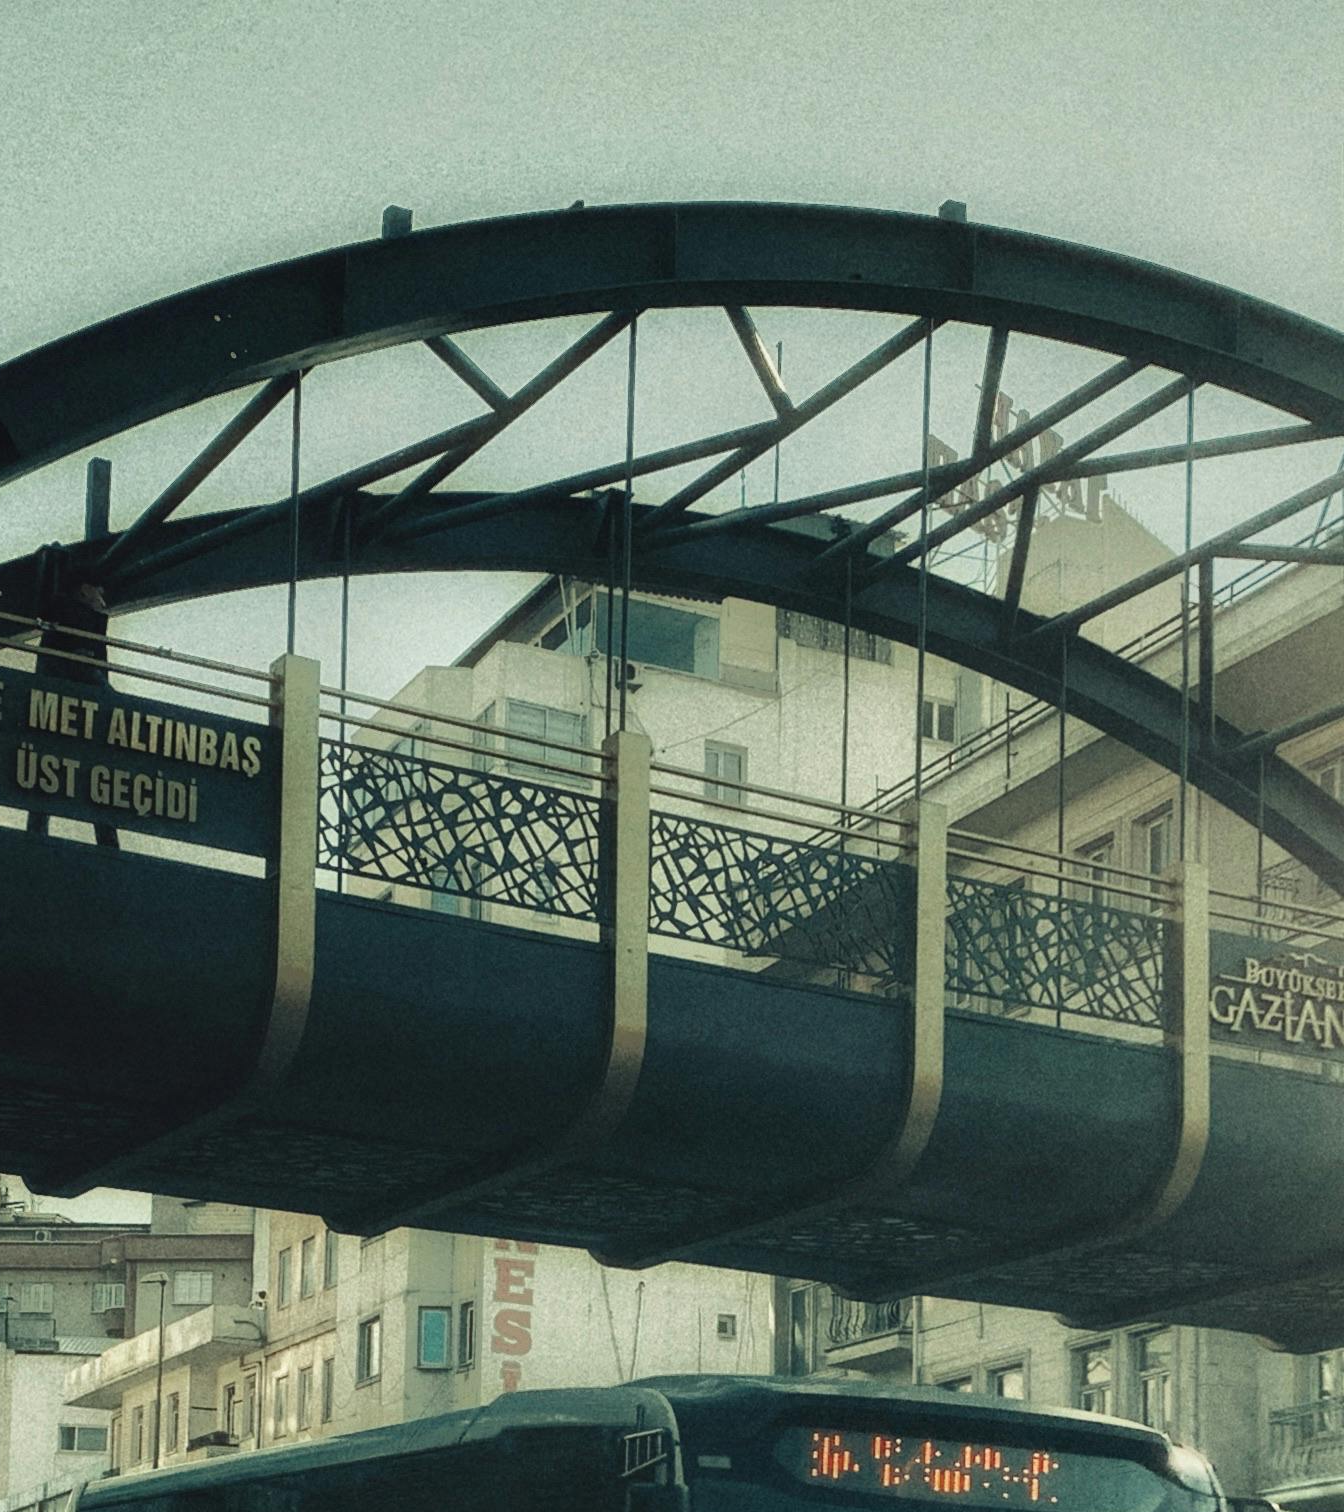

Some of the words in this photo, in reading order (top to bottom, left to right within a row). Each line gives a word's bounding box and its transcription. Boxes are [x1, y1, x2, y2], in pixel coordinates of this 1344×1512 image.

[28, 688, 100, 740] MET
[107, 707, 262, 778] ALTINBAŞ
[15, 741, 81, 798] ÜST
[90, 764, 198, 823] GEÇİDİ
